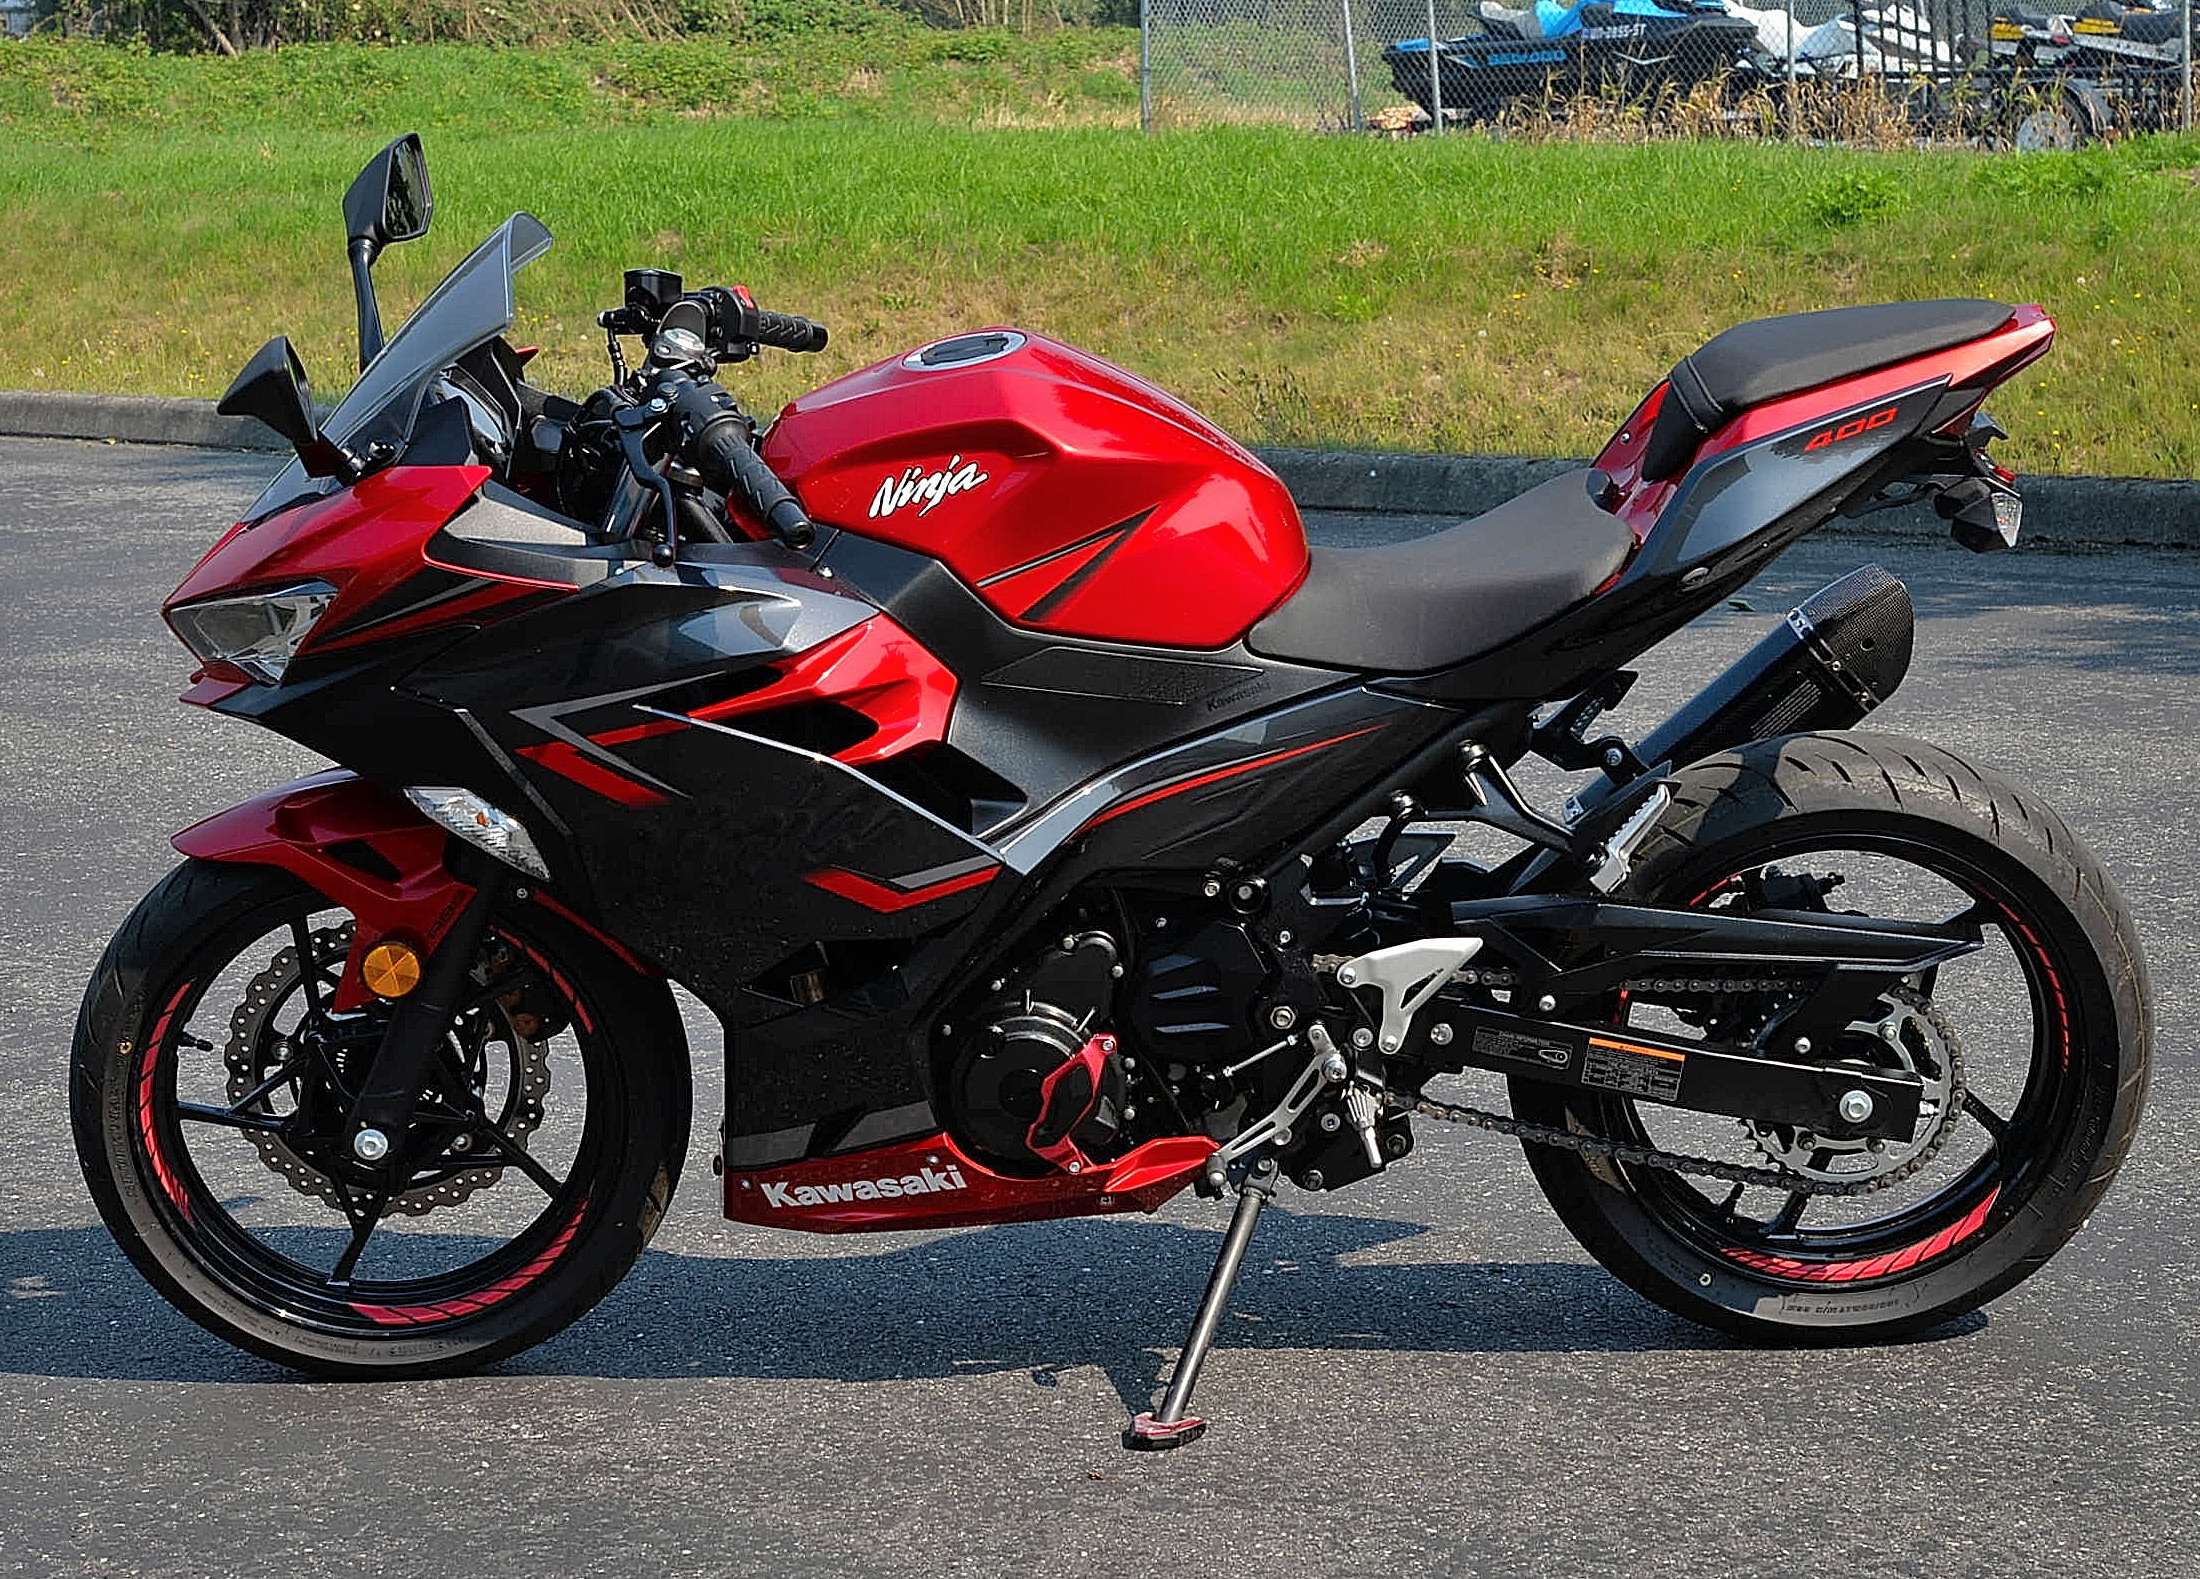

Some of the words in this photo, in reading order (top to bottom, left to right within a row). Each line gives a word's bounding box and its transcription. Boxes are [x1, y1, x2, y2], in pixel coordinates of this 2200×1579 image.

[1803, 407, 1898, 453] 400
[868, 453, 989, 519] Ninja
[760, 1164, 968, 1209] Kawasaki
